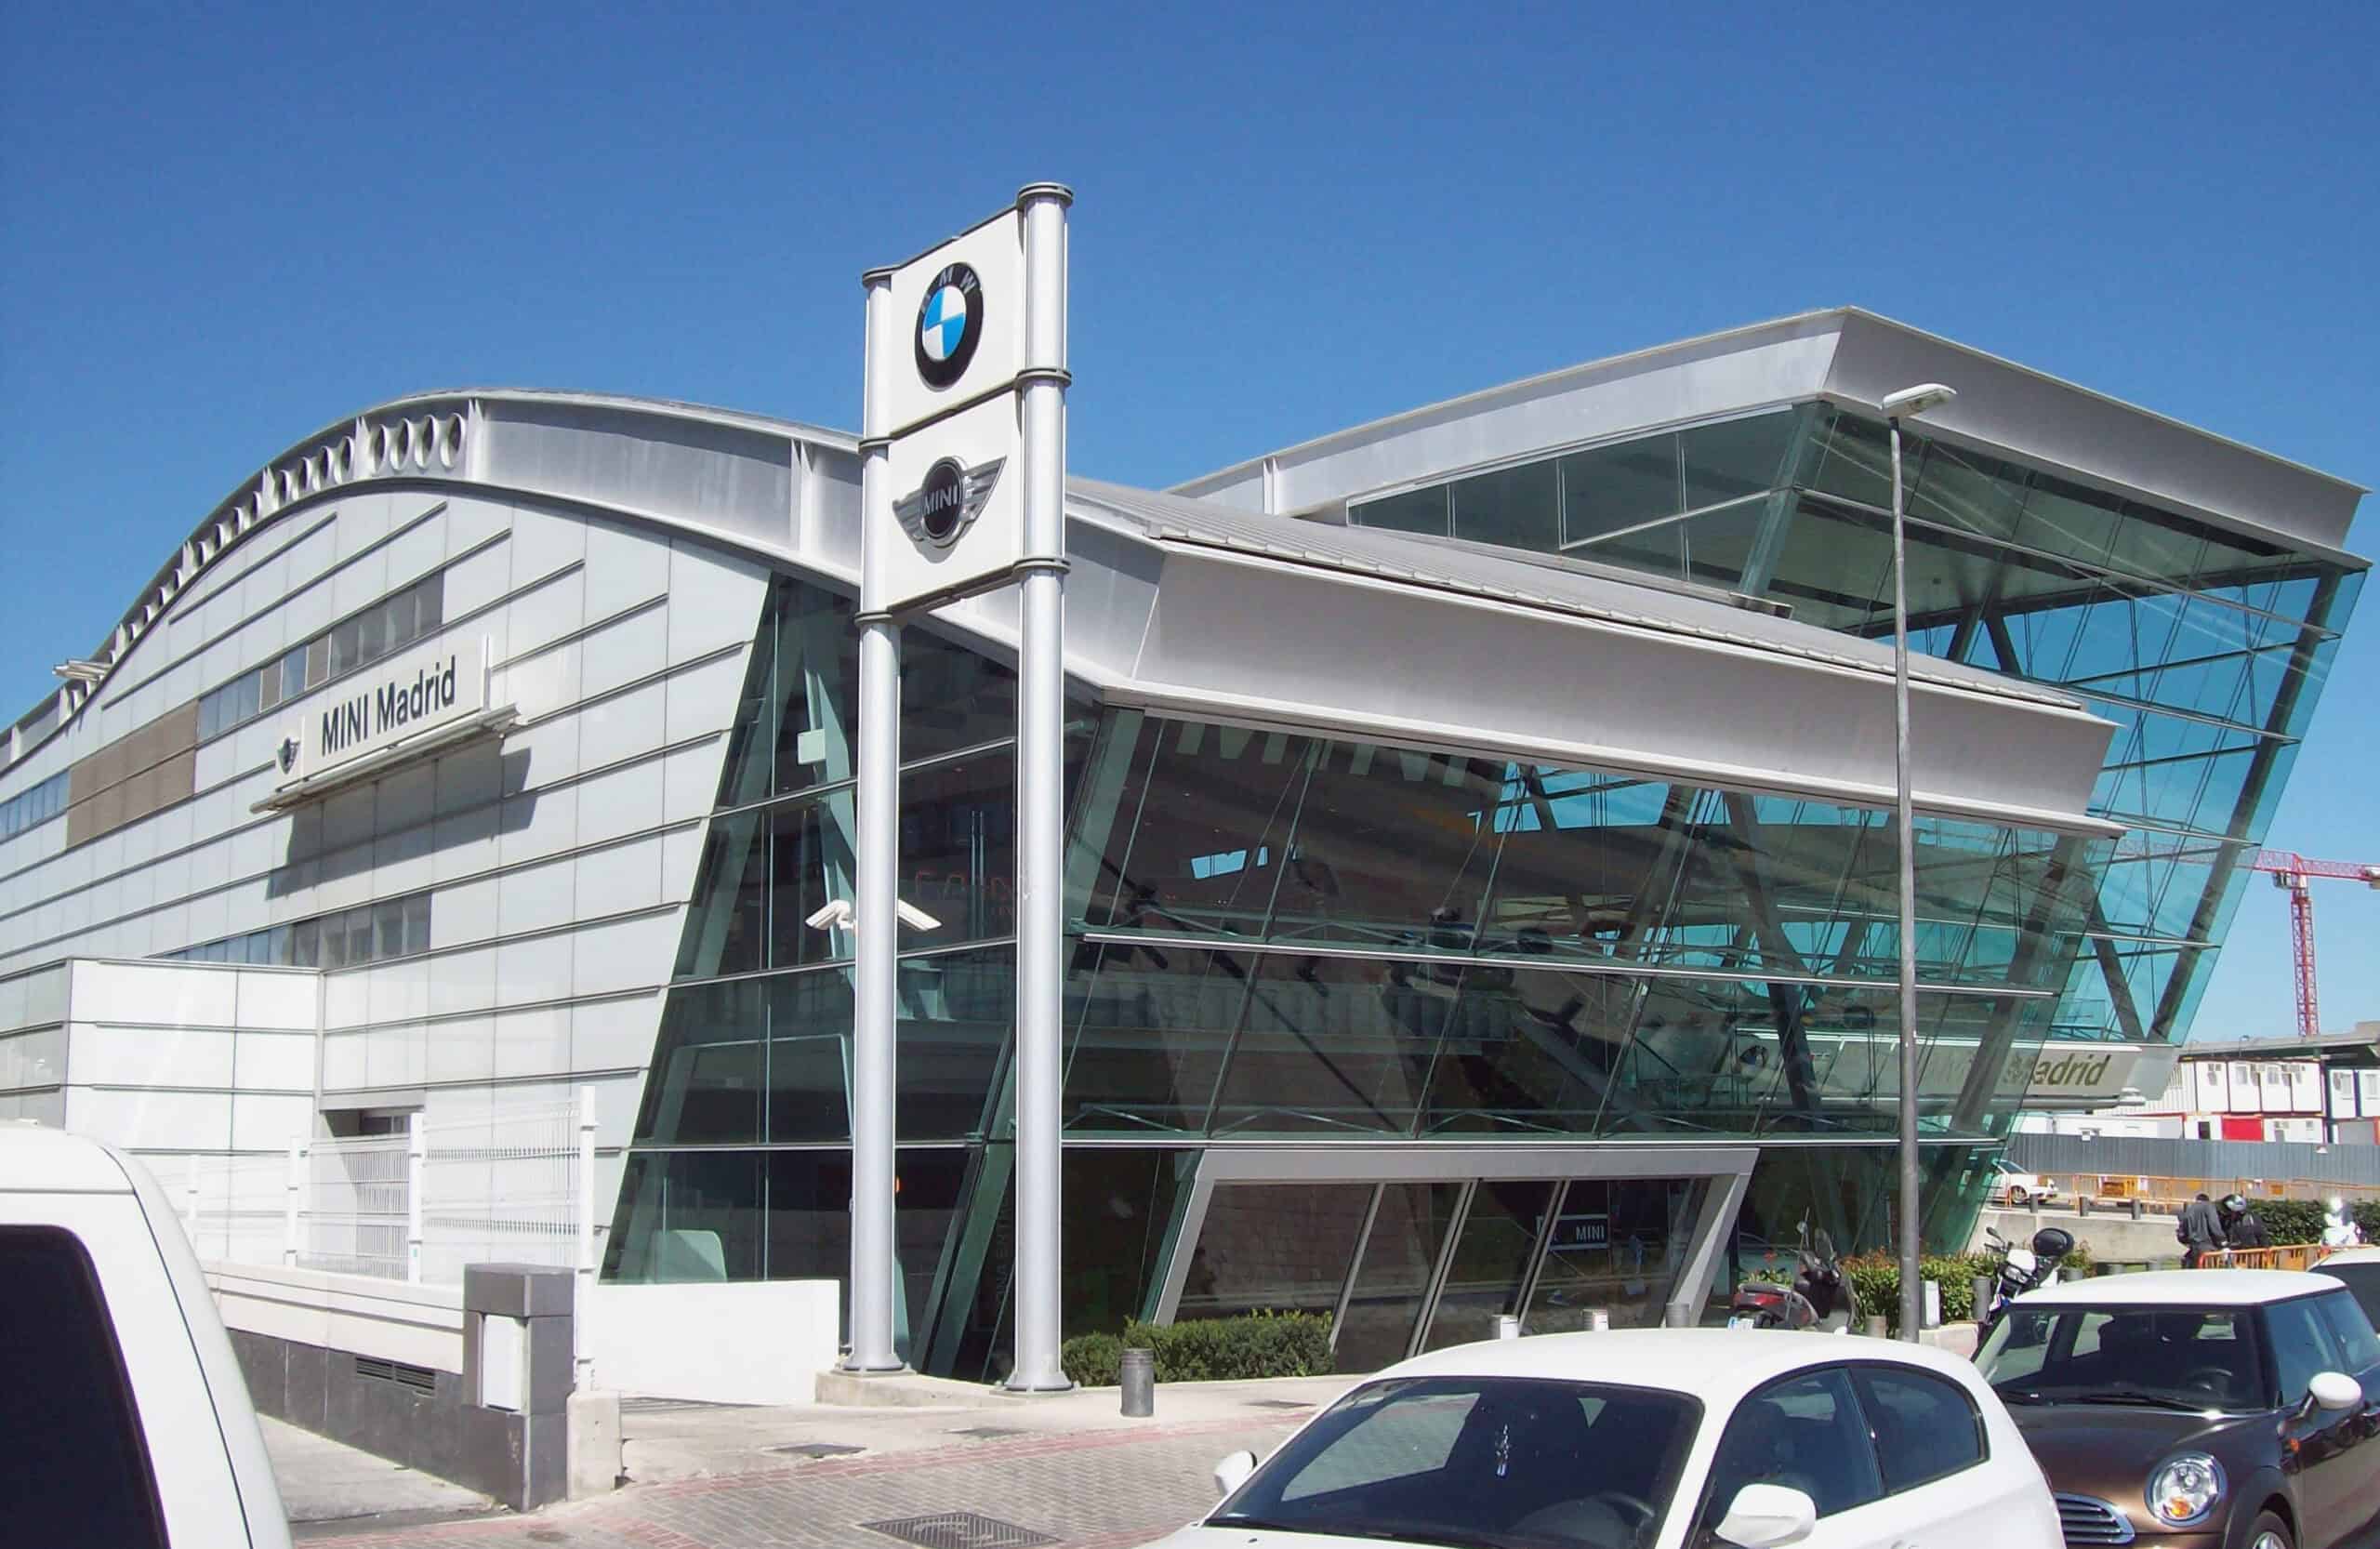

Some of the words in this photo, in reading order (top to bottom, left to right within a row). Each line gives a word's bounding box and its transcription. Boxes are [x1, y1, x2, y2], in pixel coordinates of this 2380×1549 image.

[923, 484, 958, 515] MINI
[322, 693, 369, 758] MINI
[377, 655, 456, 735] Madrid
[1576, 1225, 1606, 1242] MINI
